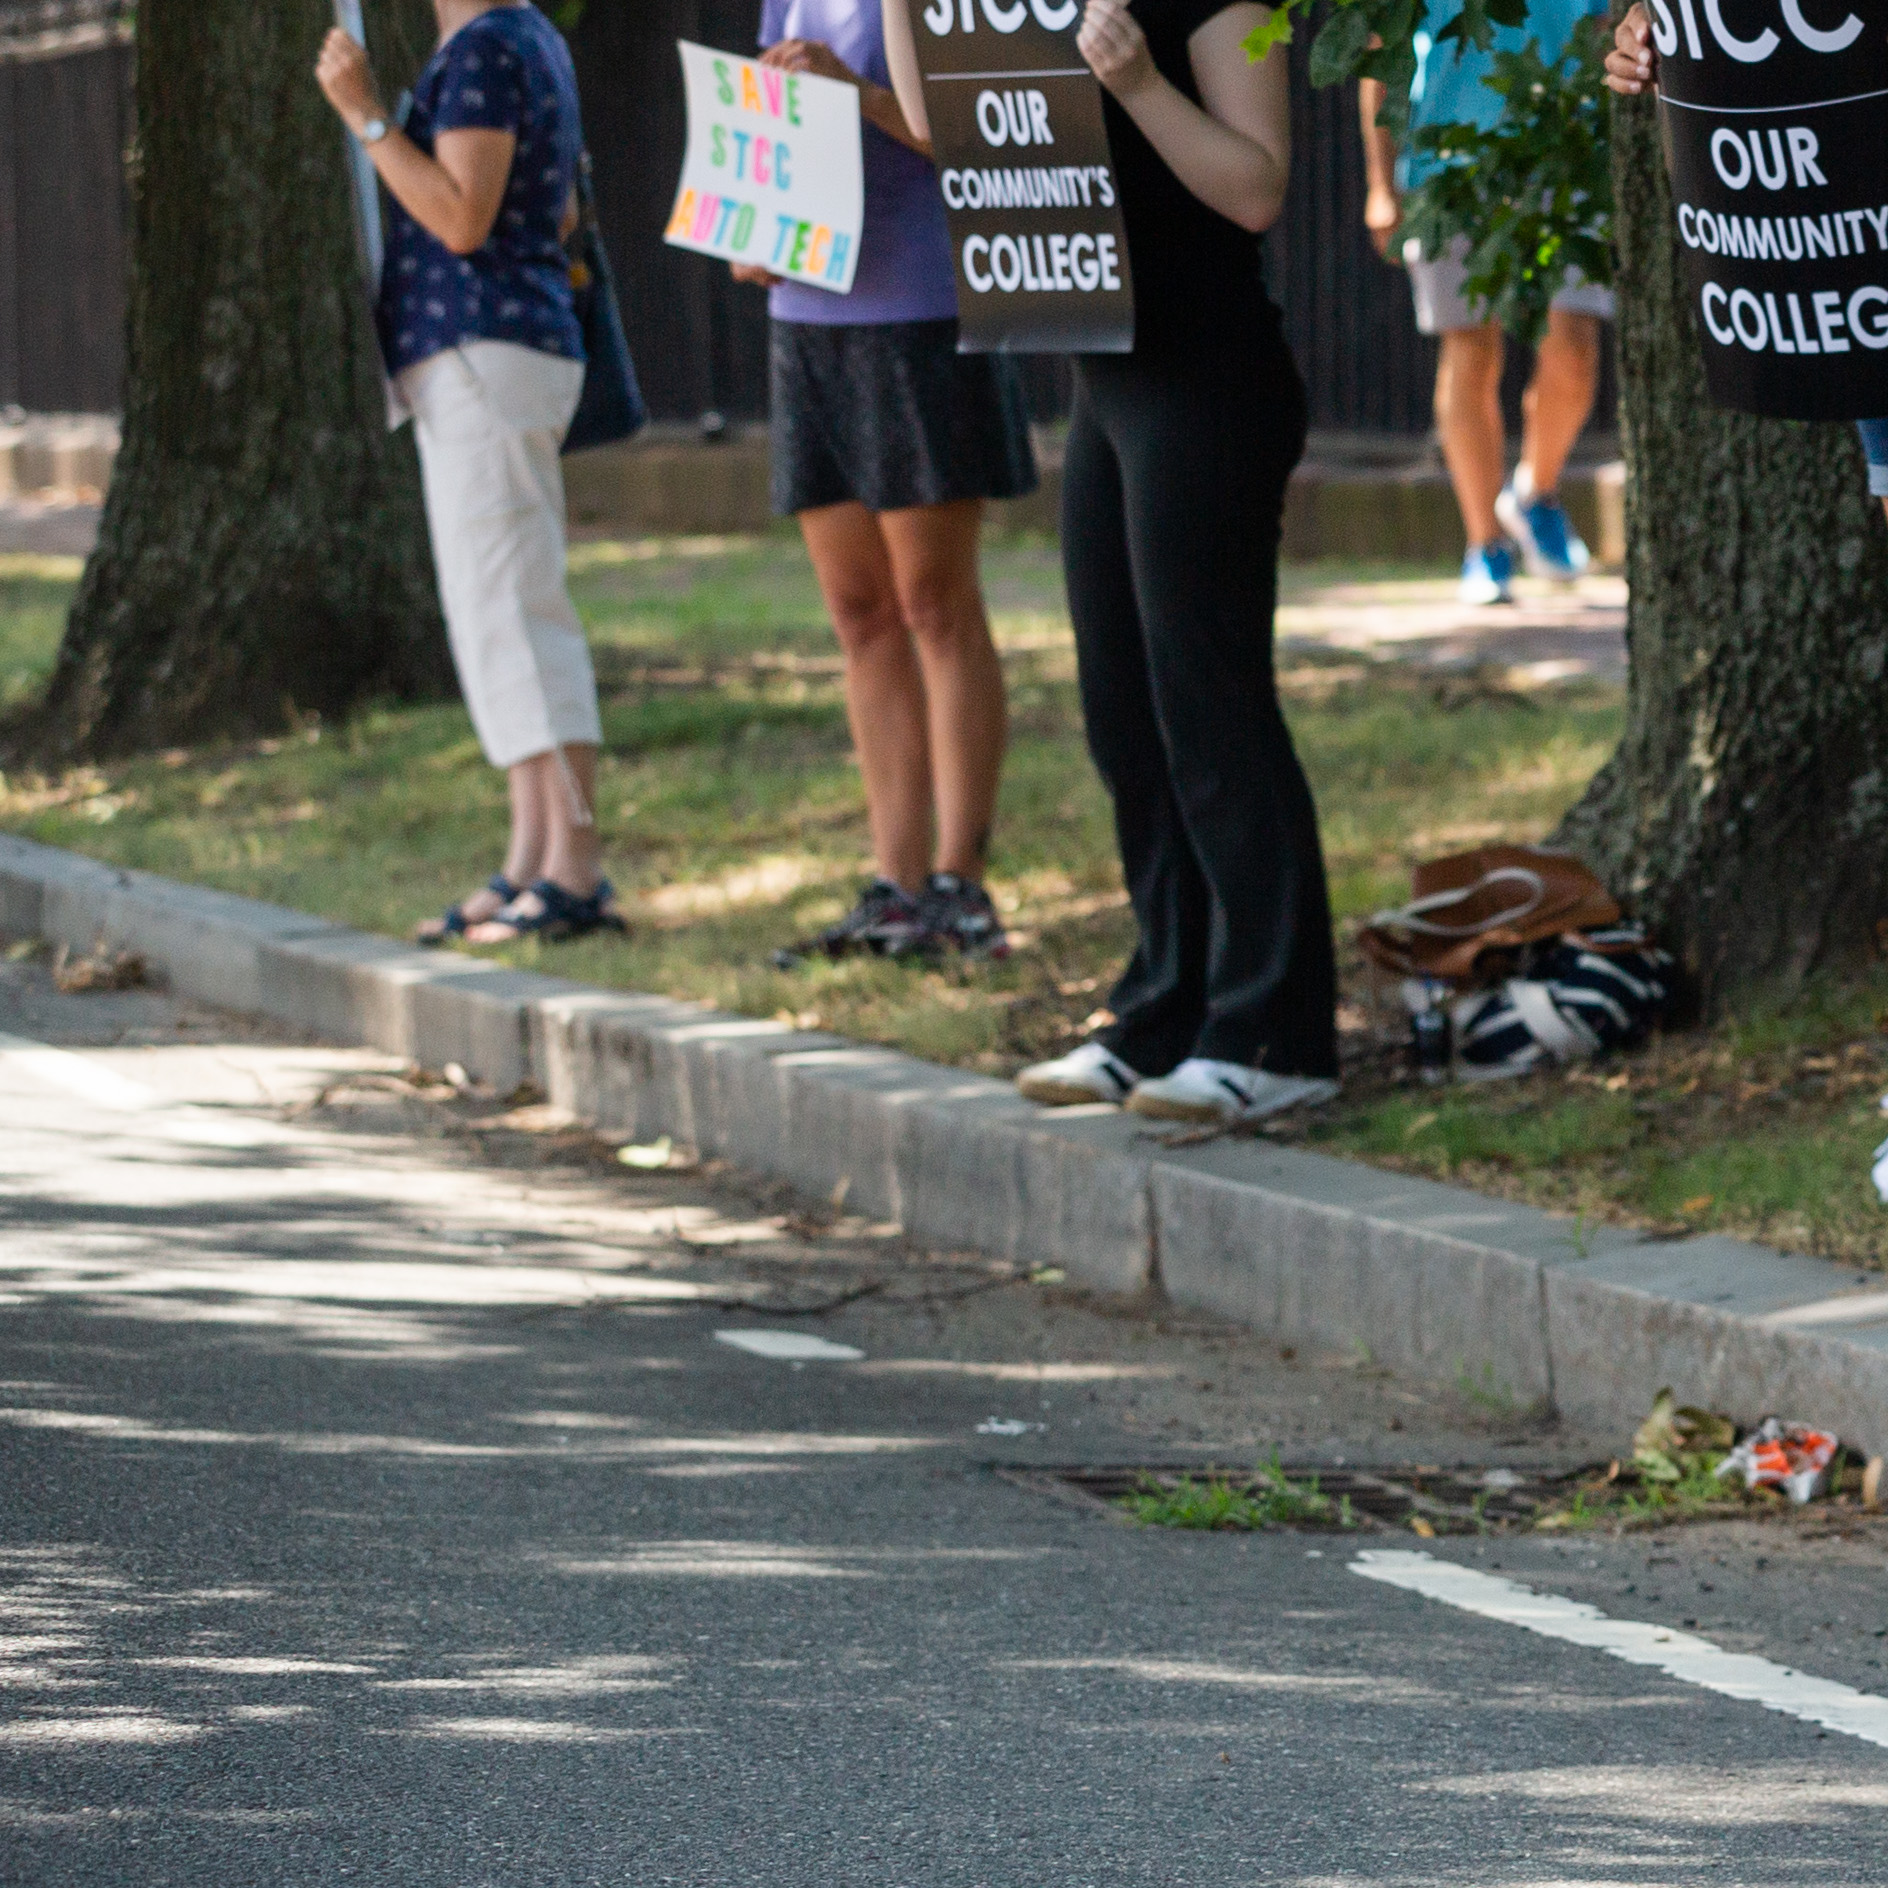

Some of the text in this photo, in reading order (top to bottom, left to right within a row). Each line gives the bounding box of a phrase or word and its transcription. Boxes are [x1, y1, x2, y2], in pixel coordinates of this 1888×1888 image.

[712, 58, 802, 128] SAVE
[978, 91, 1053, 145] OUR
[710, 122, 792, 193] STCC
[943, 167, 1114, 208] COMMUNITY'S
[1712, 128, 1826, 189] OUR
[665, 187, 851, 284] AUTO TECH
[964, 234, 1120, 292] COLLEGE
